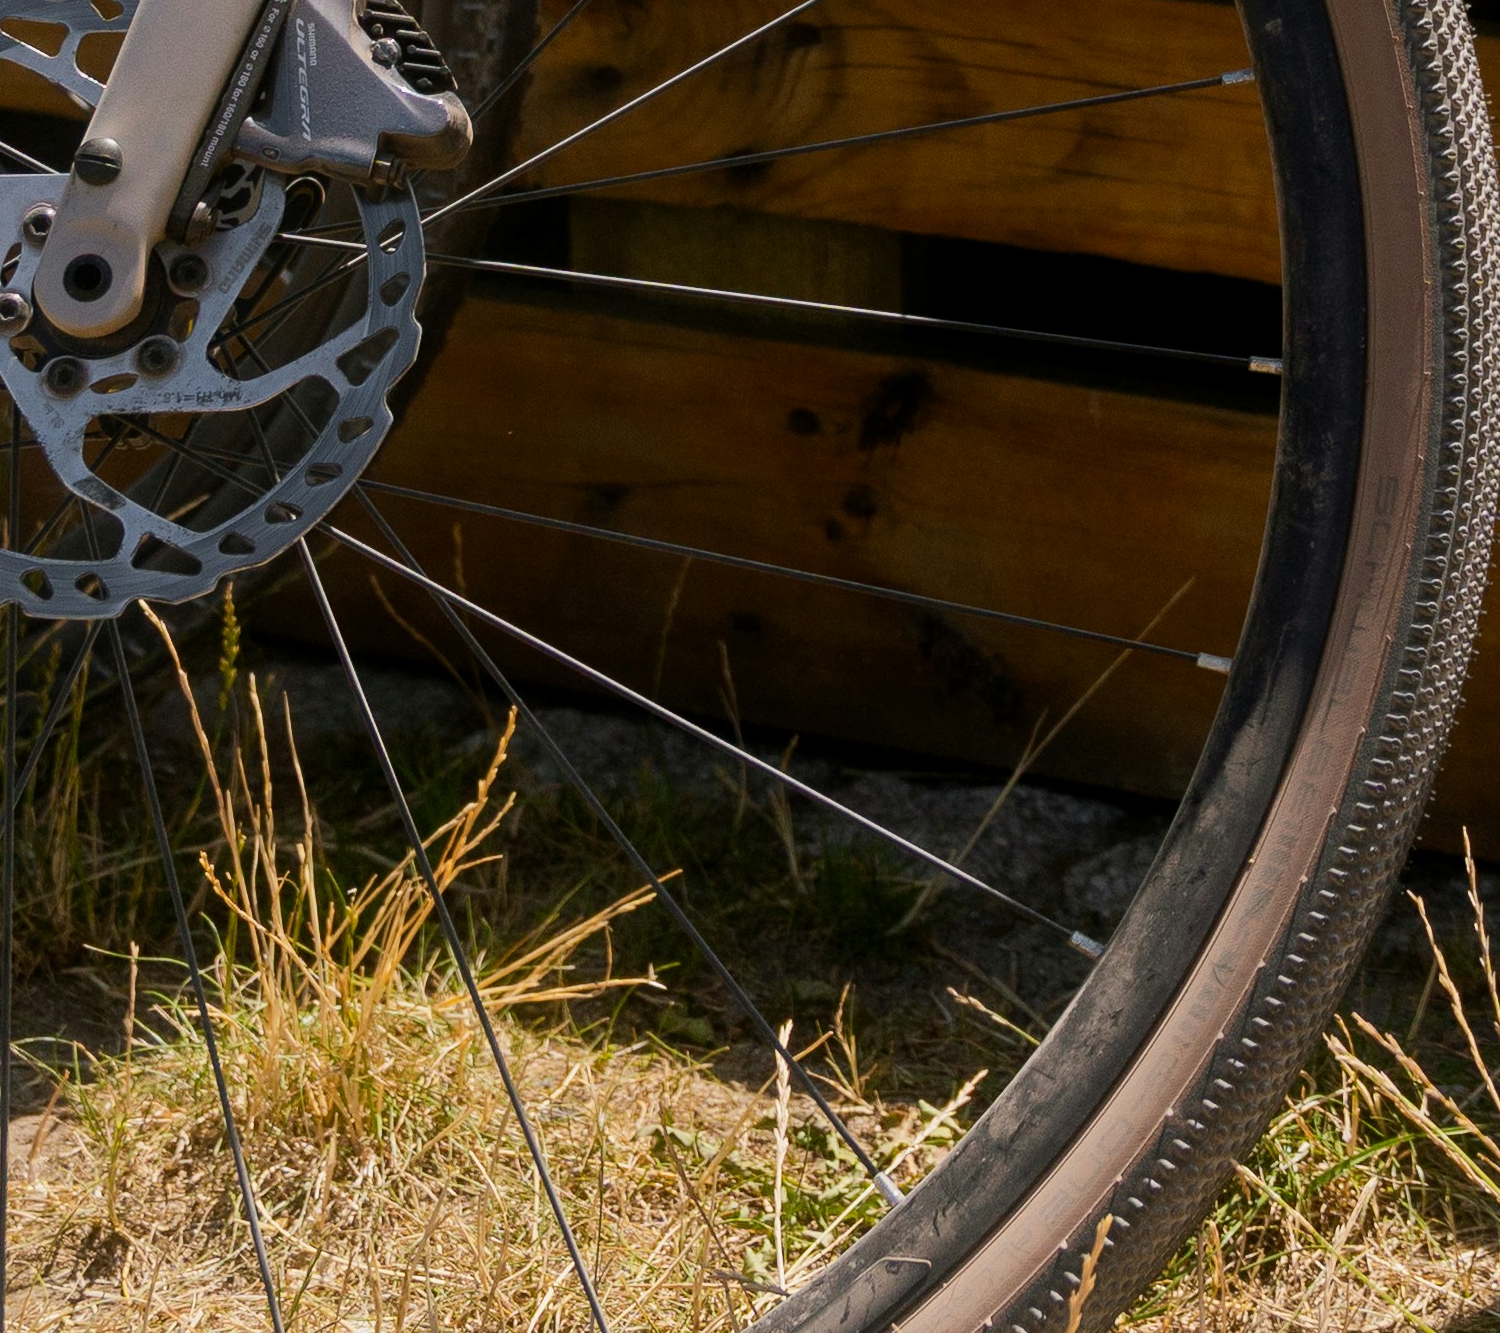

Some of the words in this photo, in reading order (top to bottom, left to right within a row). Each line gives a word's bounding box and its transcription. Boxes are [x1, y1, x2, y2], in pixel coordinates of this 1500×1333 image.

[266, 7, 280, 24] For
[249, 49, 259, 60] or
[308, 22, 317, 67] SHIMANO
[295, 17, 312, 142] ULTEGRA
[230, 87, 243, 102] for
[199, 136, 220, 168] mount
